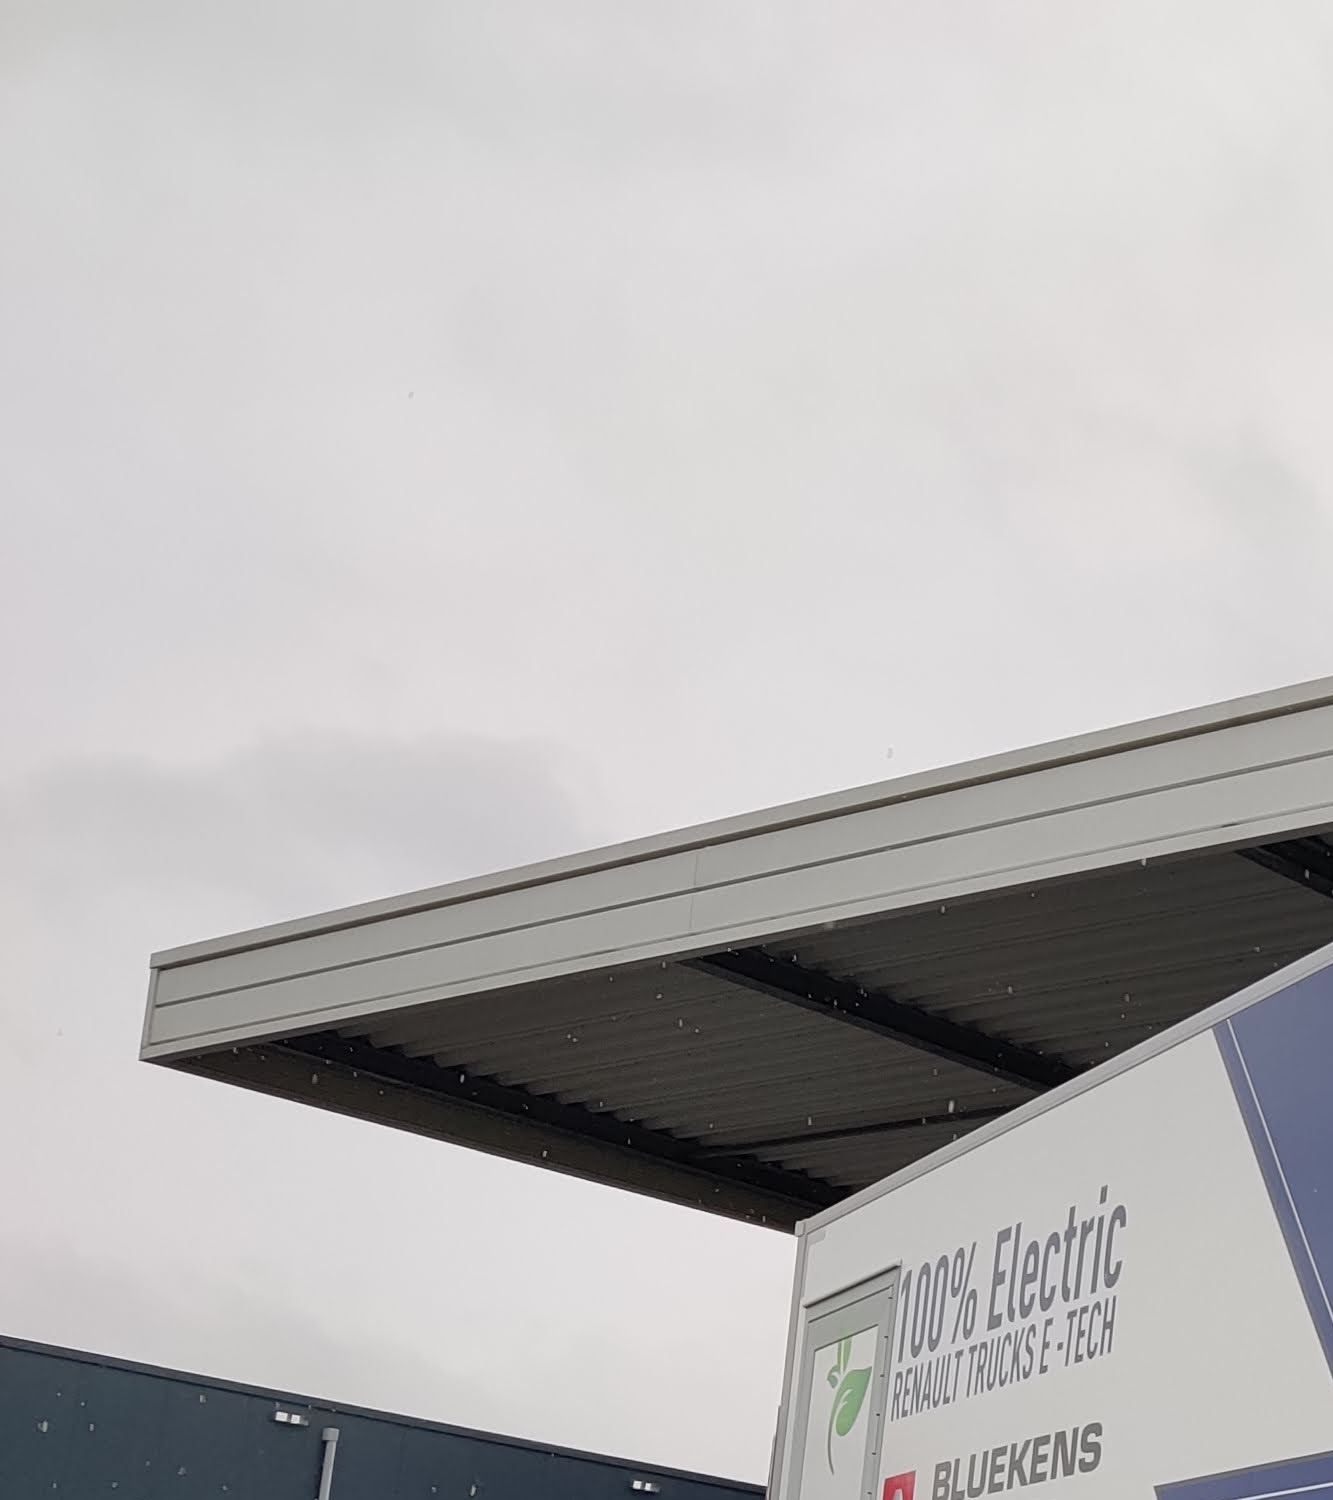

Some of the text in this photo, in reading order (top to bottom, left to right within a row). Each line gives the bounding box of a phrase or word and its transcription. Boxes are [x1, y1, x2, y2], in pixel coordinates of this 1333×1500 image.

[897, 1184, 1127, 1364] 100% Electric
[890, 1350, 964, 1422] RENAULT
[966, 1323, 1037, 1399] TRUCKS
